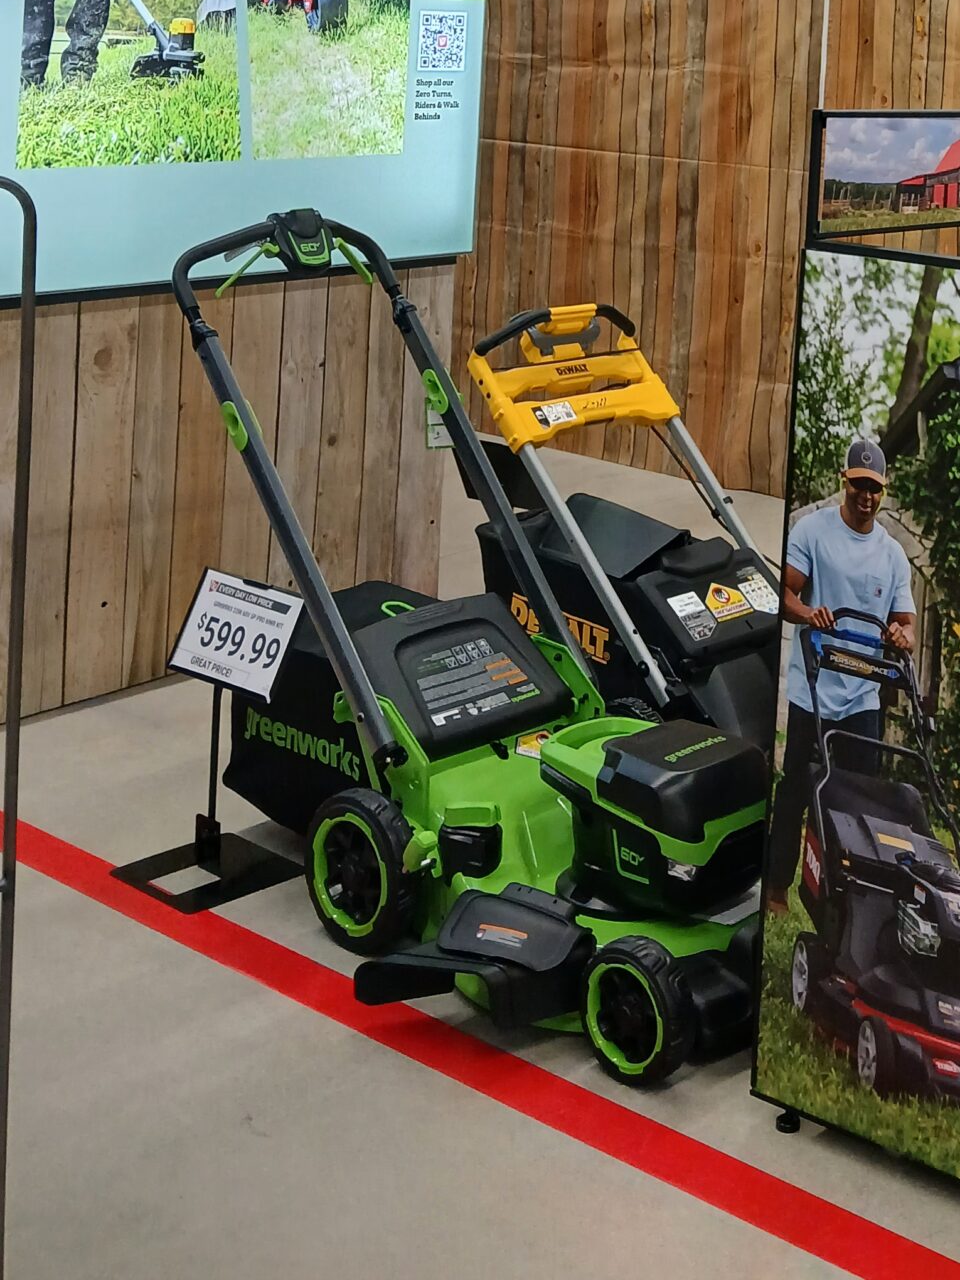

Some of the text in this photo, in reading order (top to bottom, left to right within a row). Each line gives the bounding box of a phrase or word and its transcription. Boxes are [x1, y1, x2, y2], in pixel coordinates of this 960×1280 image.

[416, 79, 432, 88] Shop
[219, 583, 274, 609] EVERY DAY LOW PRICE
[197, 612, 280, 668] $599.99
[191, 656, 232, 678] GREAT PRICE!
[244, 706, 360, 782] greenworks
[664, 736, 726, 763] greenworks
